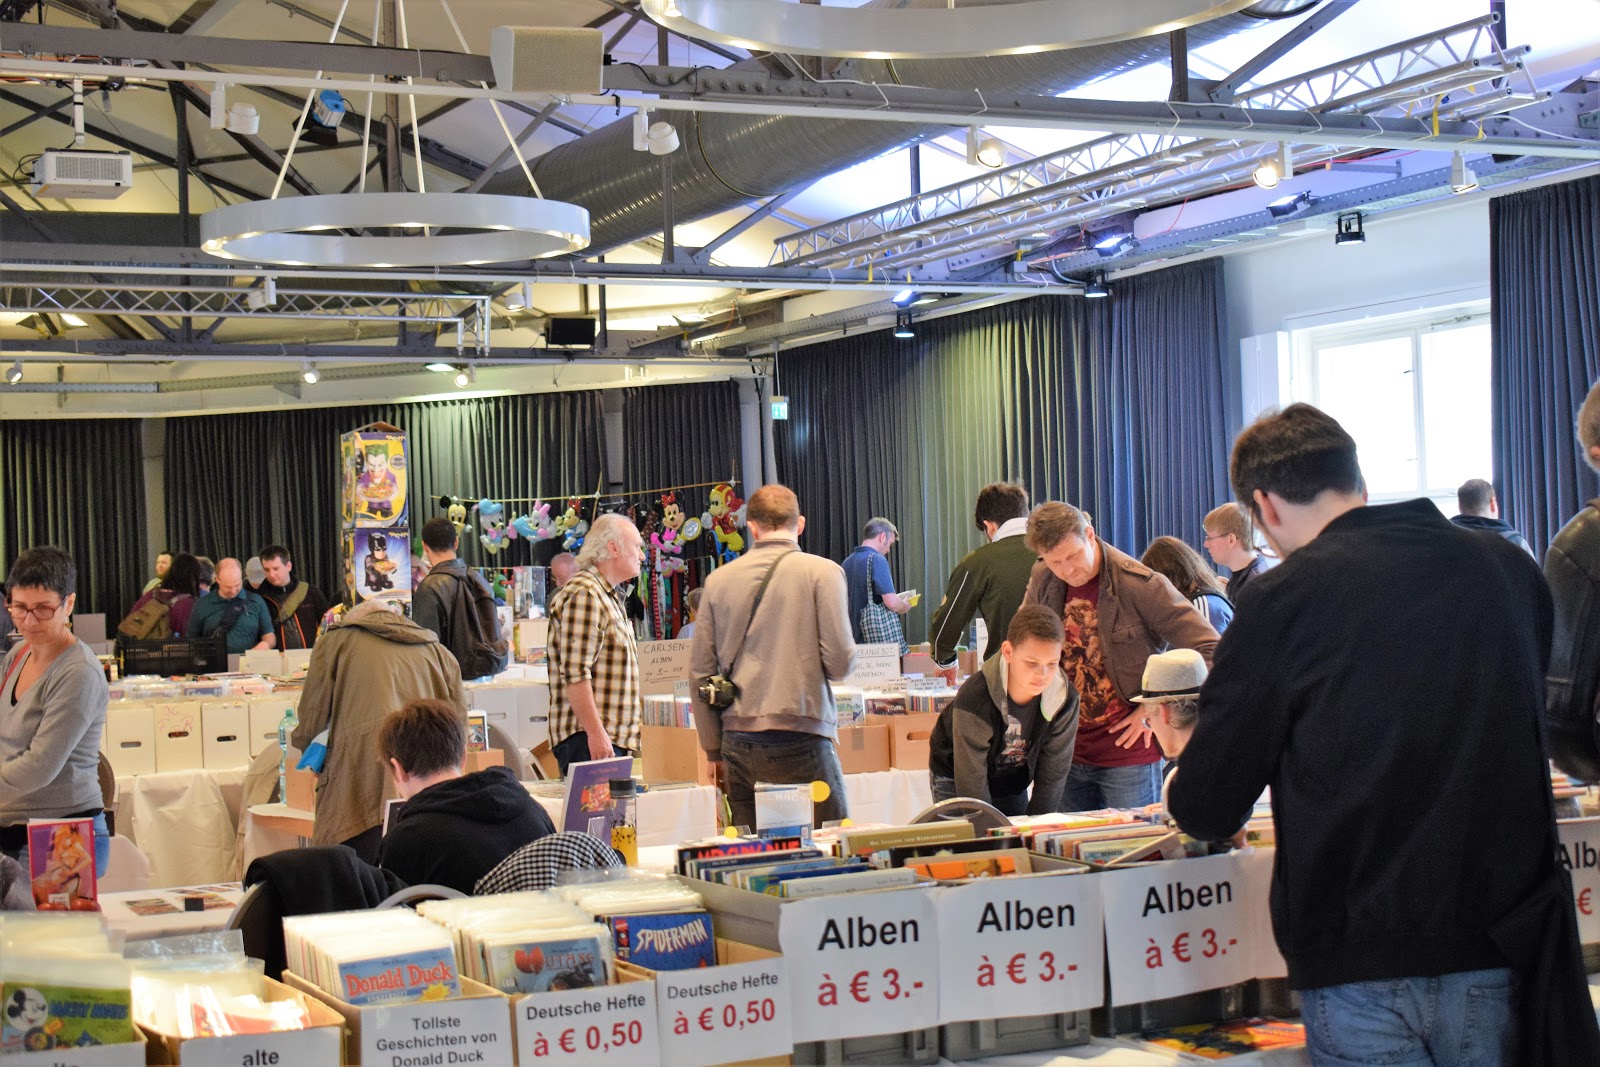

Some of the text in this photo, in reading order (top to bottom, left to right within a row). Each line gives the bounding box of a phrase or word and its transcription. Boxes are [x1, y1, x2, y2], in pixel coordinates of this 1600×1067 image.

[643, 643, 690, 654] CARLSEN-
[651, 656, 673, 665] ALBEN
[1558, 840, 1600, 869] Alb
[1142, 880, 1233, 918] Alben
[1576, 887, 1592, 915] €
[977, 899, 1075, 933] Alben
[635, 919, 708, 953] SPIDER-MAN
[817, 916, 919, 951] Alben
[1145, 927, 1238, 969] à € 3.-
[345, 961, 454, 996] Donald Duck
[976, 951, 1078, 987] à € 3.-
[667, 972, 779, 999] Deutsche Hefte
[817, 968, 924, 1006] à € 3.-
[526, 993, 646, 1020] Deutsche Hefte
[673, 997, 776, 1035] à € 0,50
[412, 1017, 461, 1030] Tollste
[533, 1020, 643, 1057] à € 0,50
[376, 1033, 497, 1052] Geschichten von
[242, 1050, 280, 1067] alte
[392, 1050, 484, 1067] Donald Duck
